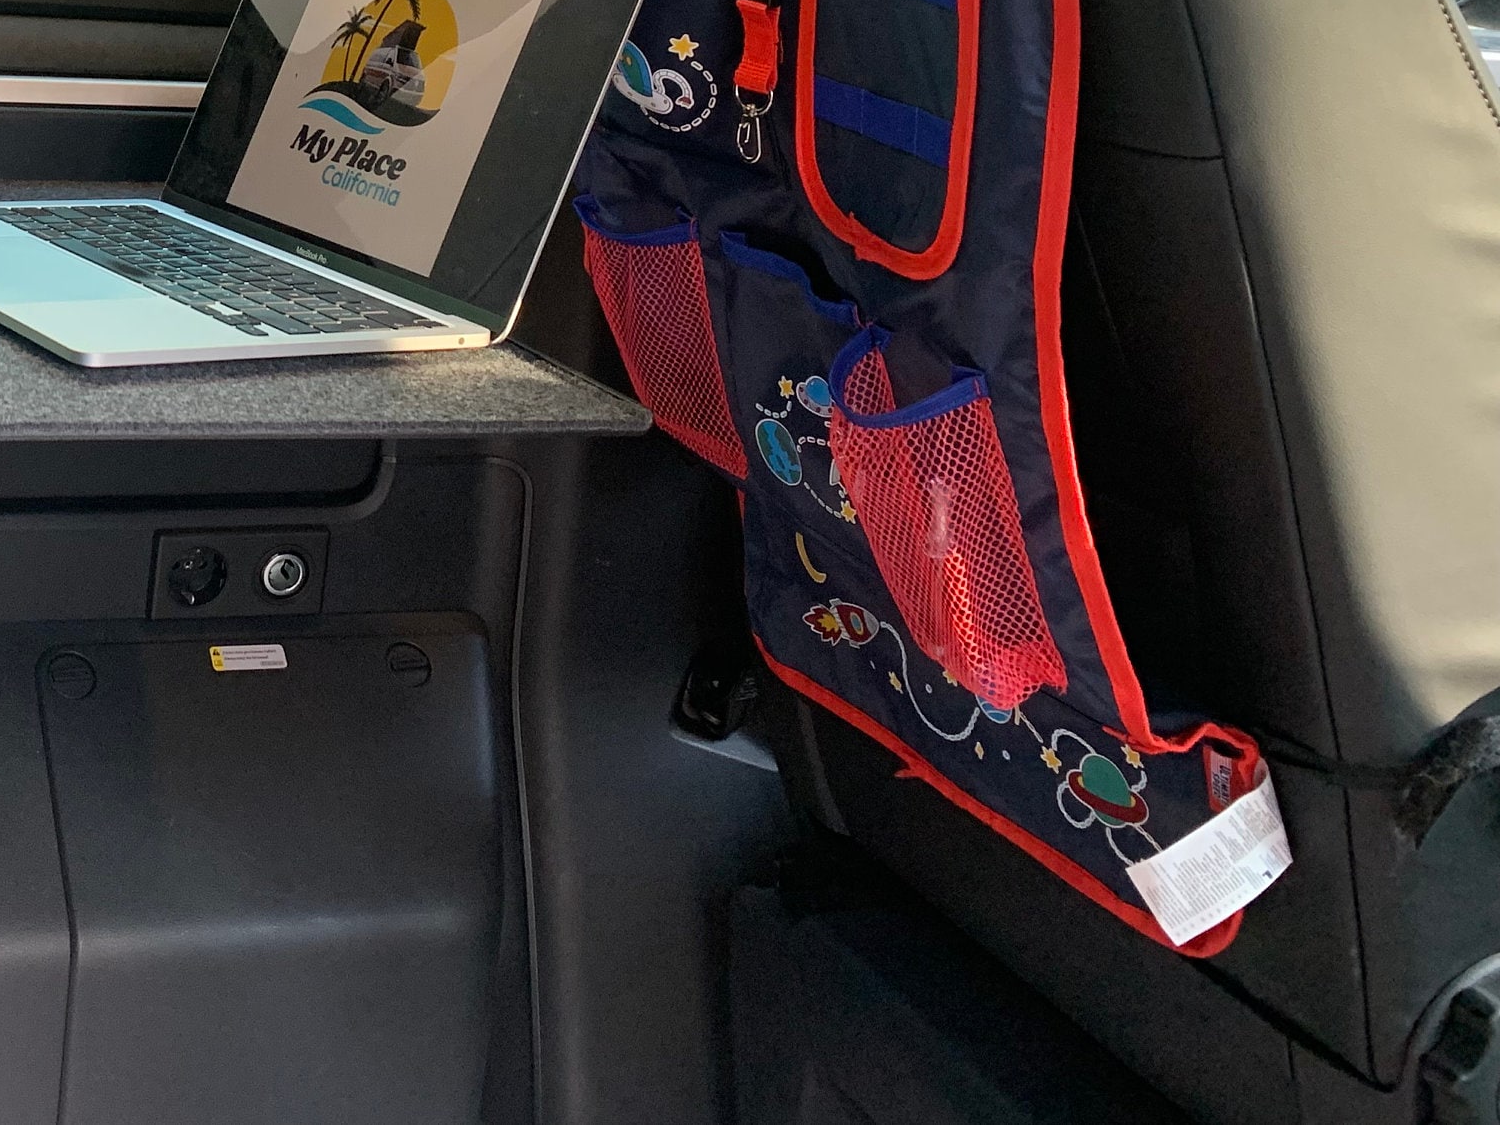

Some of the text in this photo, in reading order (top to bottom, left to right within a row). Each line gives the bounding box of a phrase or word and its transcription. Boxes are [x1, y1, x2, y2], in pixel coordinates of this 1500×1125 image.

[290, 124, 407, 180] My Place
[322, 164, 400, 206] California
